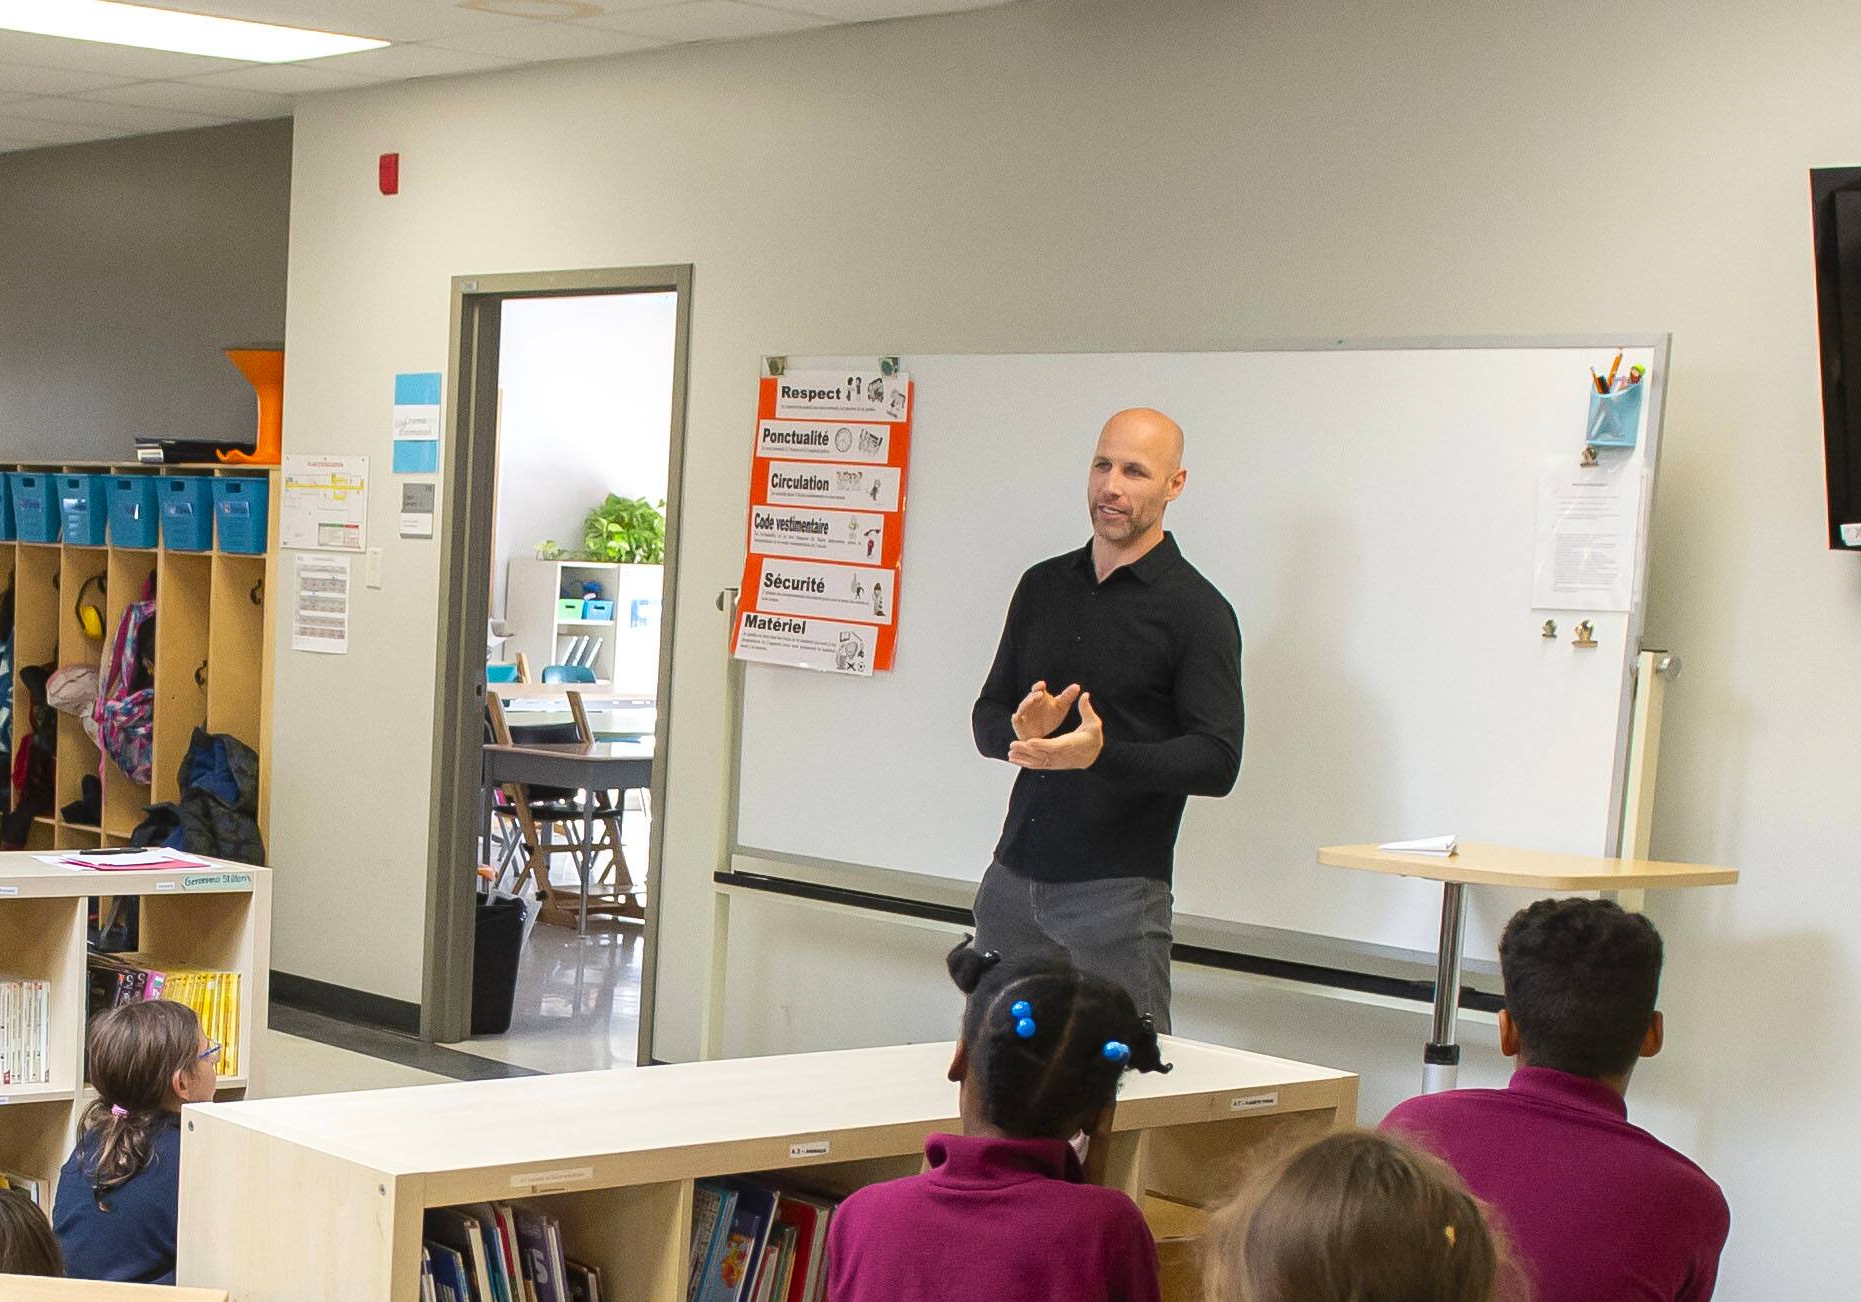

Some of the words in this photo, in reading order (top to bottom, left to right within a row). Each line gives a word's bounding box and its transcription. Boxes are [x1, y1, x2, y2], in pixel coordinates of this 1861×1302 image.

[781, 385, 842, 402] Respect
[762, 428, 829, 446] Ponctualité
[771, 473, 830, 491] Circulation
[754, 513, 774, 530] Code
[776, 515, 829, 535] vestimentaire
[763, 572, 825, 593] Sécurité
[744, 614, 807, 635] Matériel
